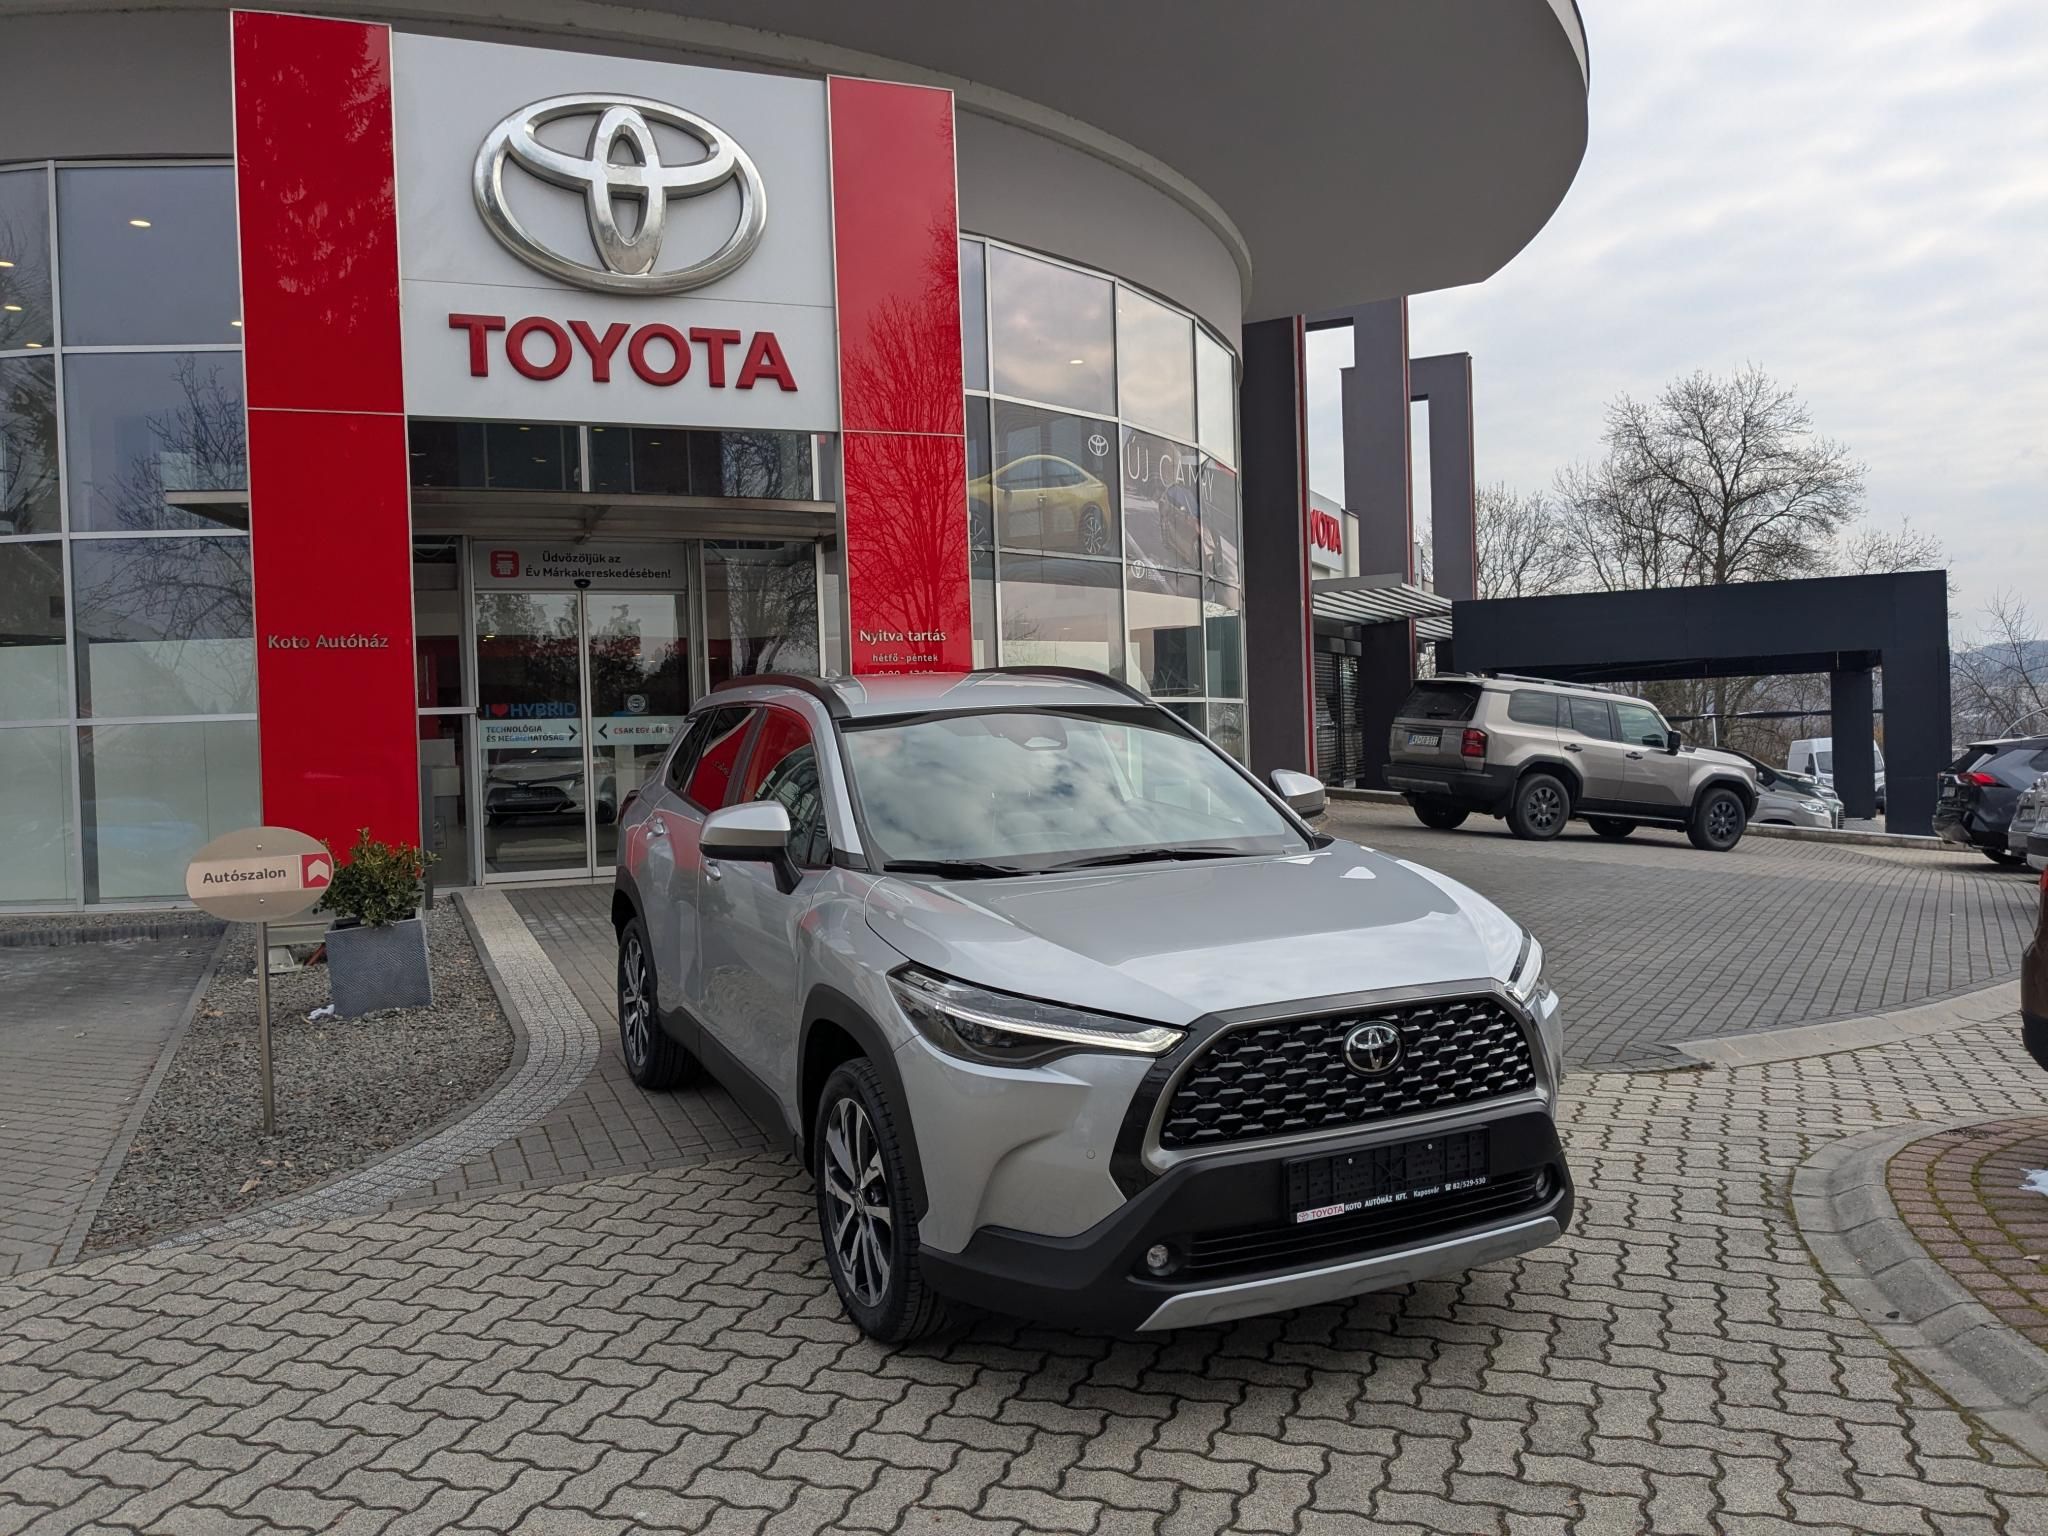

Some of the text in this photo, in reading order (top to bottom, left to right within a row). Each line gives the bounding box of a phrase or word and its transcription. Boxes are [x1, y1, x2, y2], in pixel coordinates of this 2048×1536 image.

[448, 313, 798, 392] TOYOTA
[1127, 435, 1149, 482] ÚJ
[1310, 509, 1342, 556] YOTA
[542, 551, 621, 565] Üdvözöljük az
[525, 565, 671, 579] Év Márkakereskedésében!
[268, 633, 389, 649] Koto Autóház
[860, 628, 946, 646] Nyitva tartás
[872, 652, 898, 662] hétfő
[906, 652, 938, 664] péntek
[510, 702, 577, 717] HYBRID
[486, 724, 542, 734] TECHNOLÓGIA
[613, 726, 634, 735] CSAK
[635, 726, 649, 735] EGY
[486, 735, 496, 743] ÉS
[202, 867, 287, 884] Autószalon
[1311, 1177, 1487, 1219] TOYOTA KOTO AUTÓHÁZ KFT. Kaposvár 82/529-530
